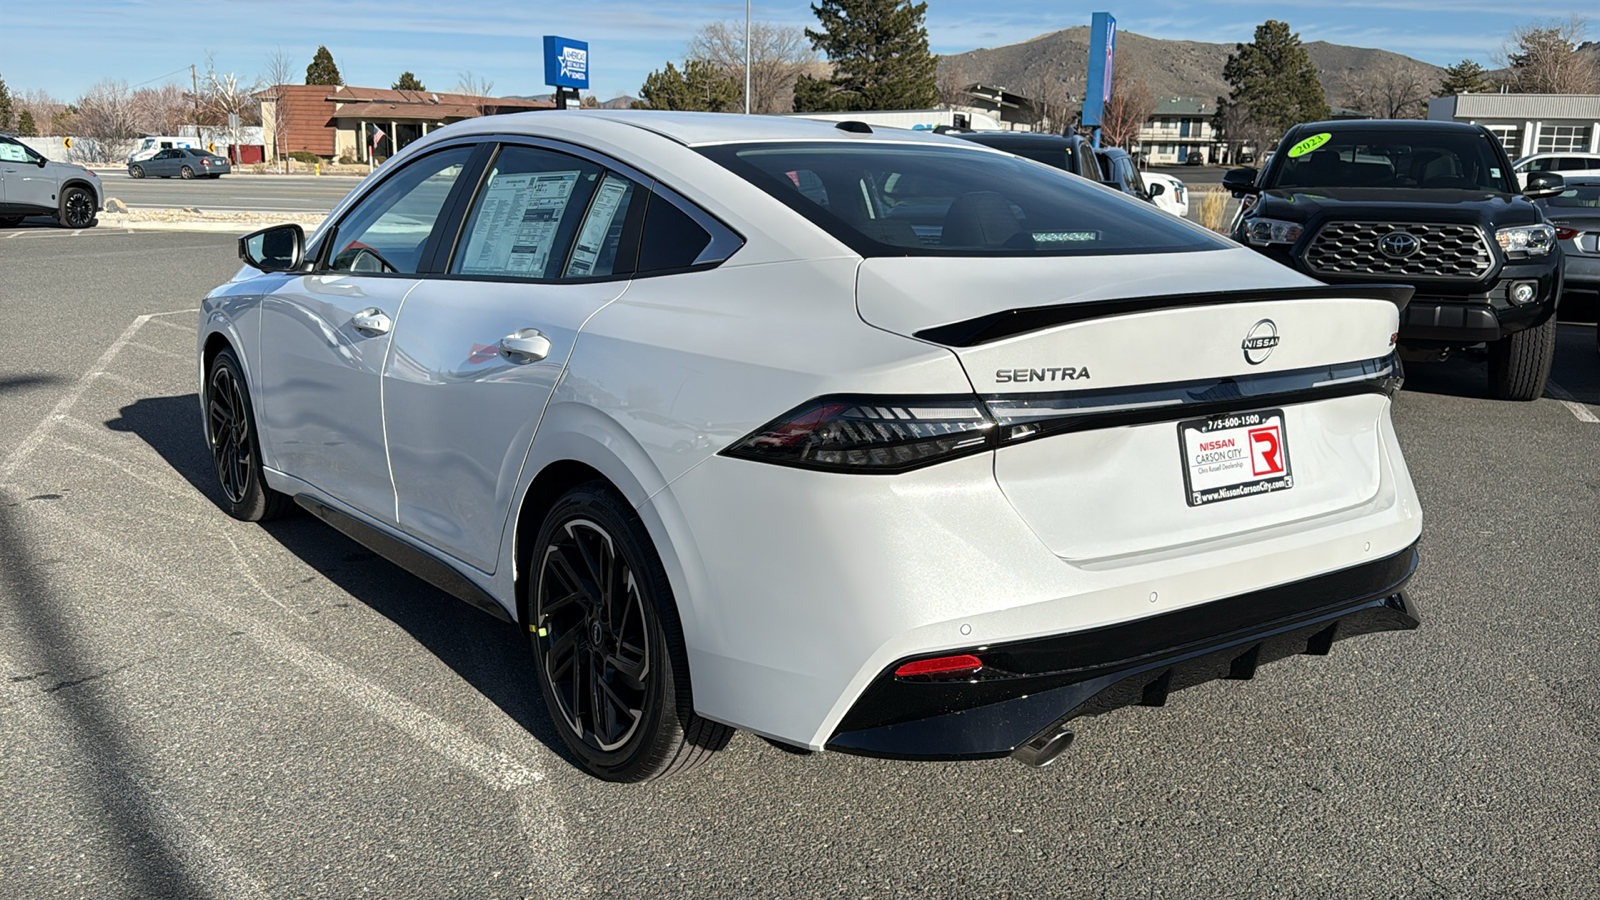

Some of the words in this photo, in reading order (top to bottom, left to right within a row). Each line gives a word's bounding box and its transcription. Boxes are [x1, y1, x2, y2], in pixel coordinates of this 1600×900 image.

[1295, 135, 1324, 154] 2023
[1243, 335, 1280, 349] NISSAN
[995, 366, 1091, 384] SENTRA
[1208, 415, 1259, 430] 775-600-1500
[1200, 438, 1235, 451] NISSAN
[1196, 451, 1226, 464] CARSON
[1227, 449, 1242, 459] CITY
[1202, 481, 1285, 502] www.NissanCarsonCity.com
